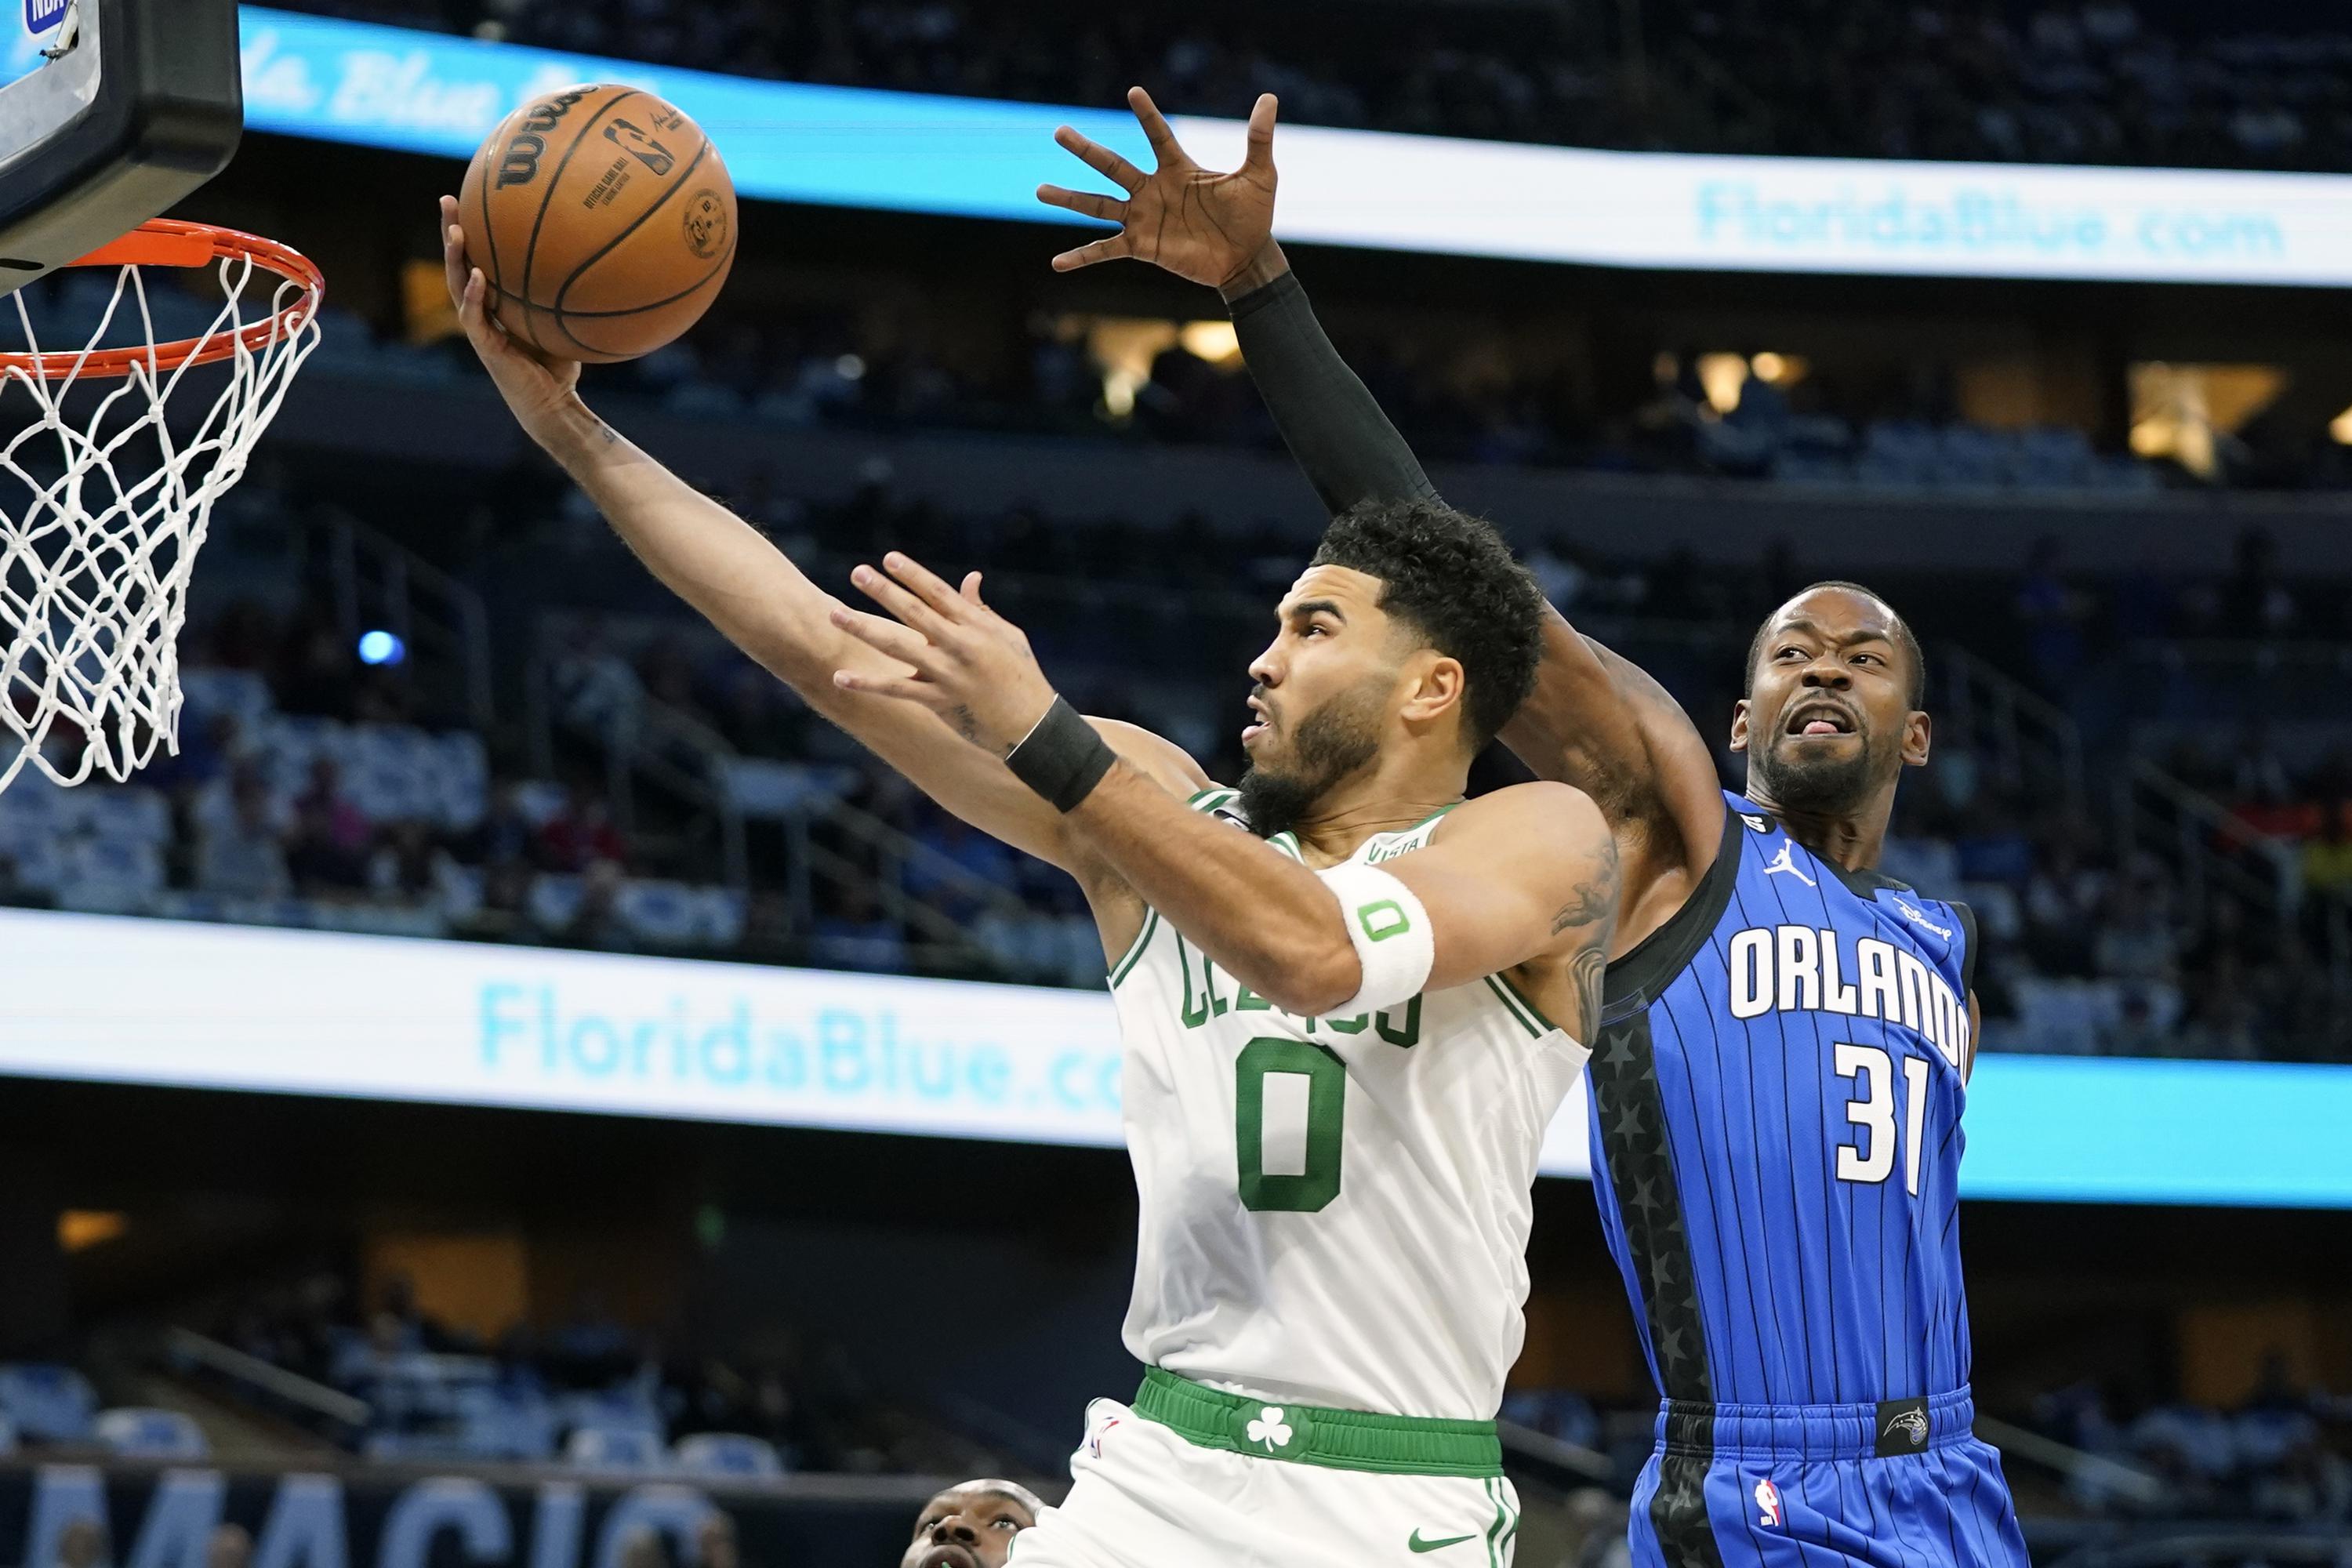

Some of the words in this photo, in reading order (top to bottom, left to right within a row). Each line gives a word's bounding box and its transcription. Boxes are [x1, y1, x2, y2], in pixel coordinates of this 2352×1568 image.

[1368, 837, 1419, 862] VISTA
[1892, 896, 1952, 942] Disney
[477, 980, 1123, 1109] FloridaBlue.co
[1730, 924, 1972, 1090] ORLANDO
[1236, 1036, 1346, 1212] 0
[1834, 1041, 1929, 1198] 31
